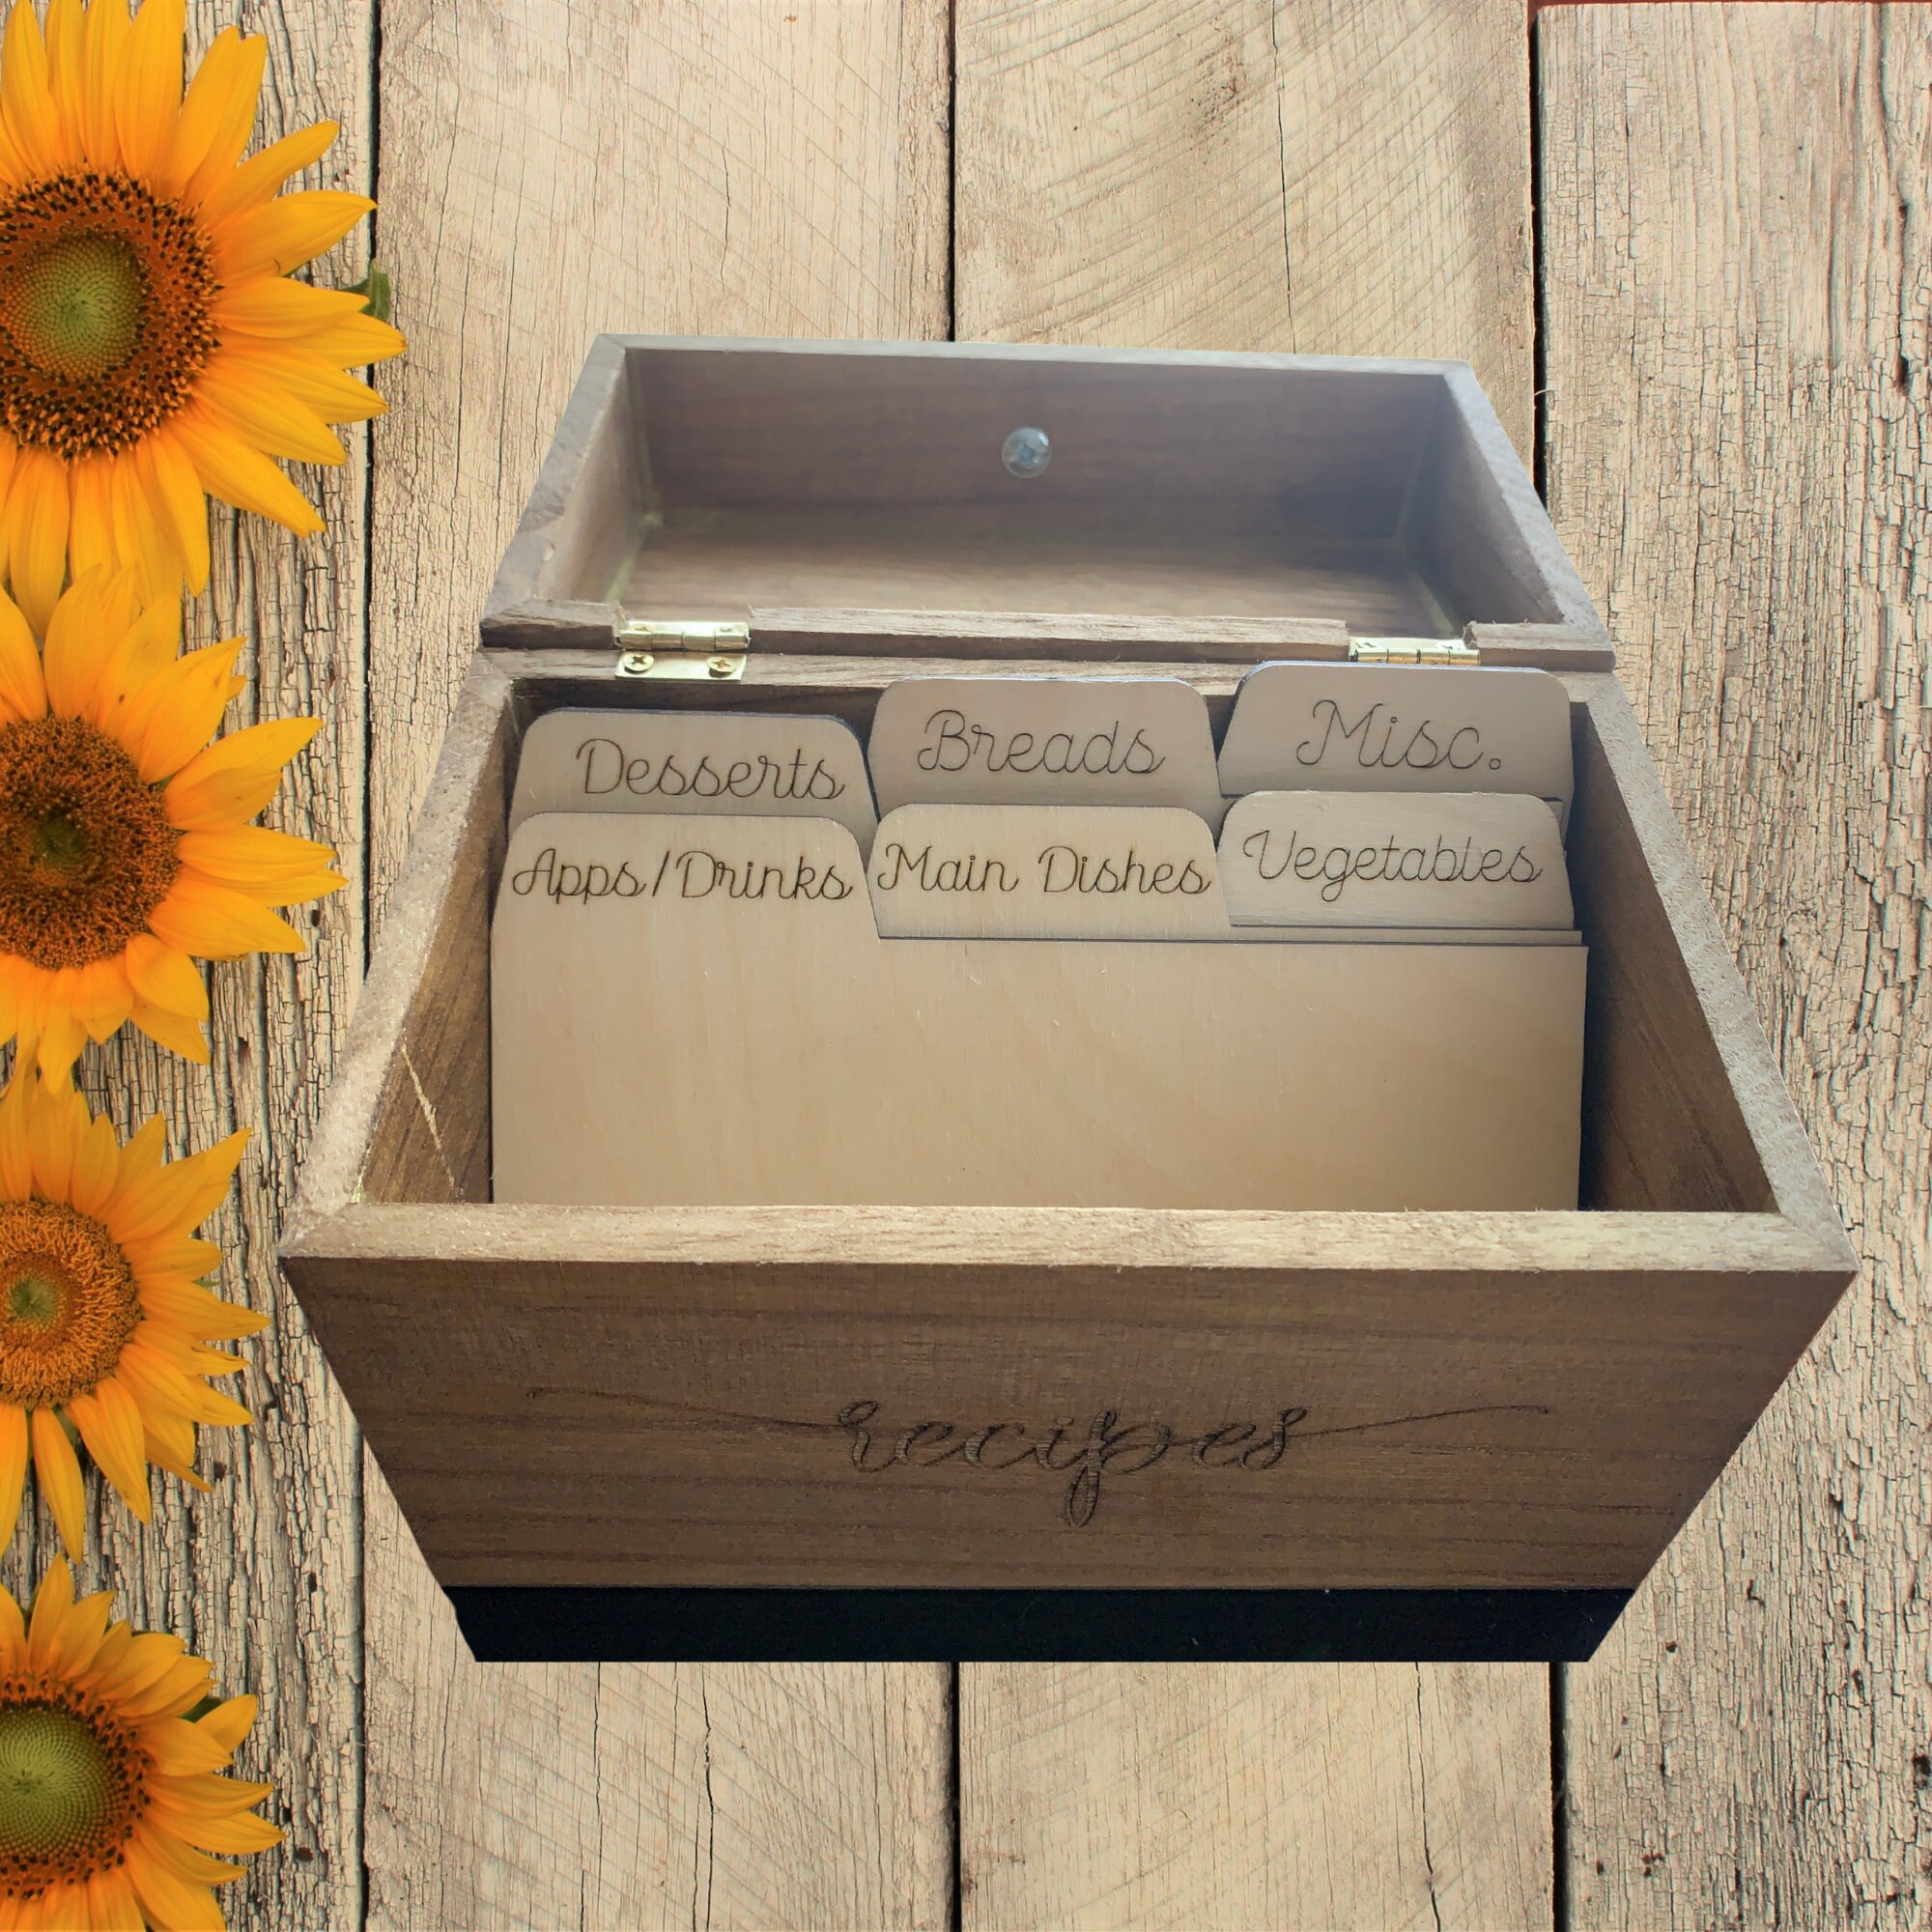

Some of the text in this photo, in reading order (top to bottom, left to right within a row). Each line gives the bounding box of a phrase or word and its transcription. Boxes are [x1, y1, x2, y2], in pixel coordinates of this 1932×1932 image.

[917, 709, 1166, 775] Breads
[1295, 698, 1502, 771] Misc.
[576, 737, 845, 801] Desserts
[511, 847, 854, 905] Apps/Drinks
[877, 842, 1211, 895] Main Dishes
[1242, 829, 1544, 903] Vegetables
[837, 1399, 1309, 1528] recipes
